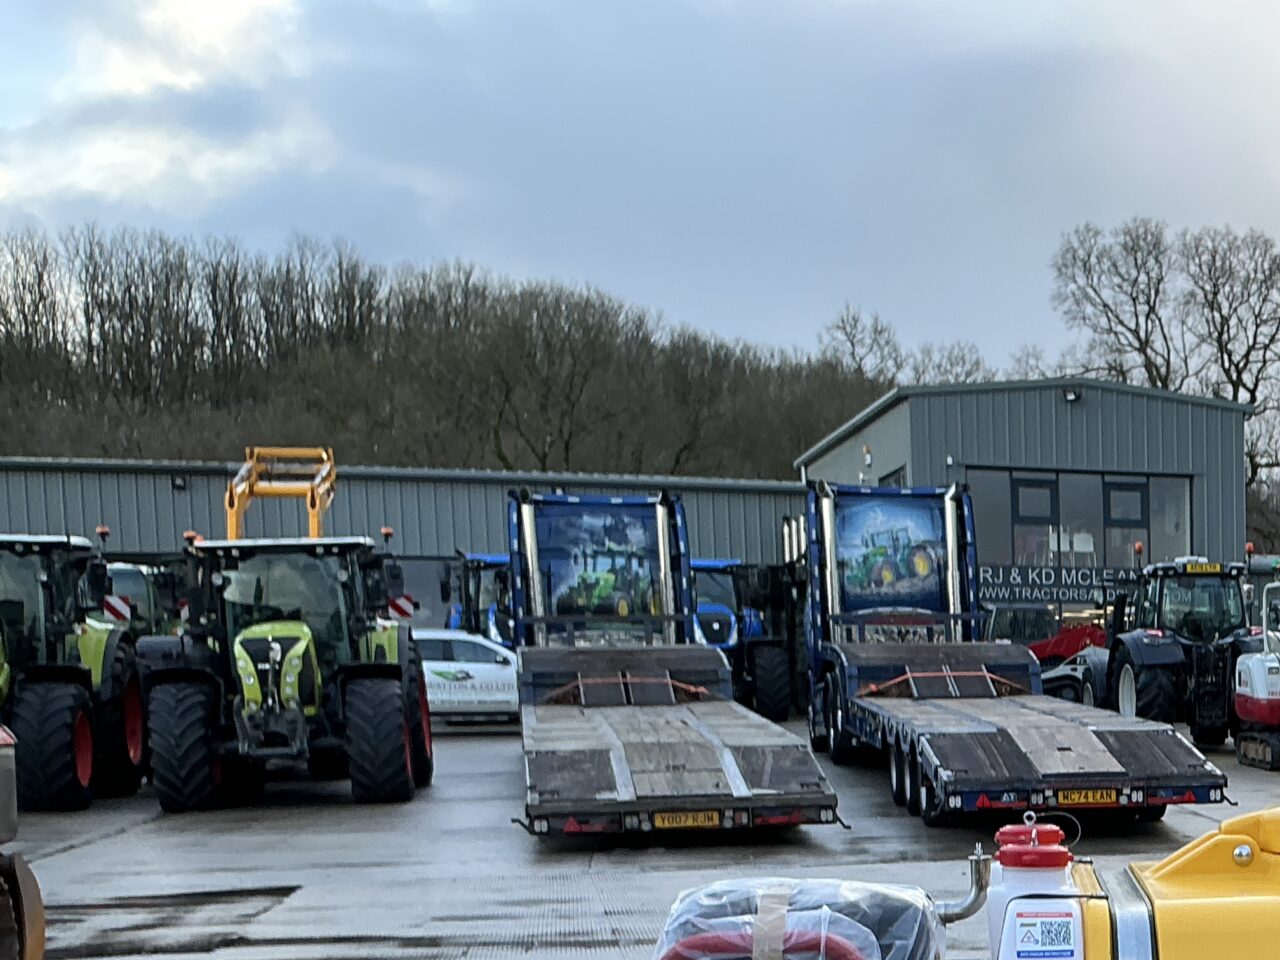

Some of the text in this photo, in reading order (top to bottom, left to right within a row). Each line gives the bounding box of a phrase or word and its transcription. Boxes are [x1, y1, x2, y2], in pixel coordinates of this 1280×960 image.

[980, 566, 1003, 584] RJ
[1009, 567, 1022, 585] &
[1028, 567, 1055, 585] KD
